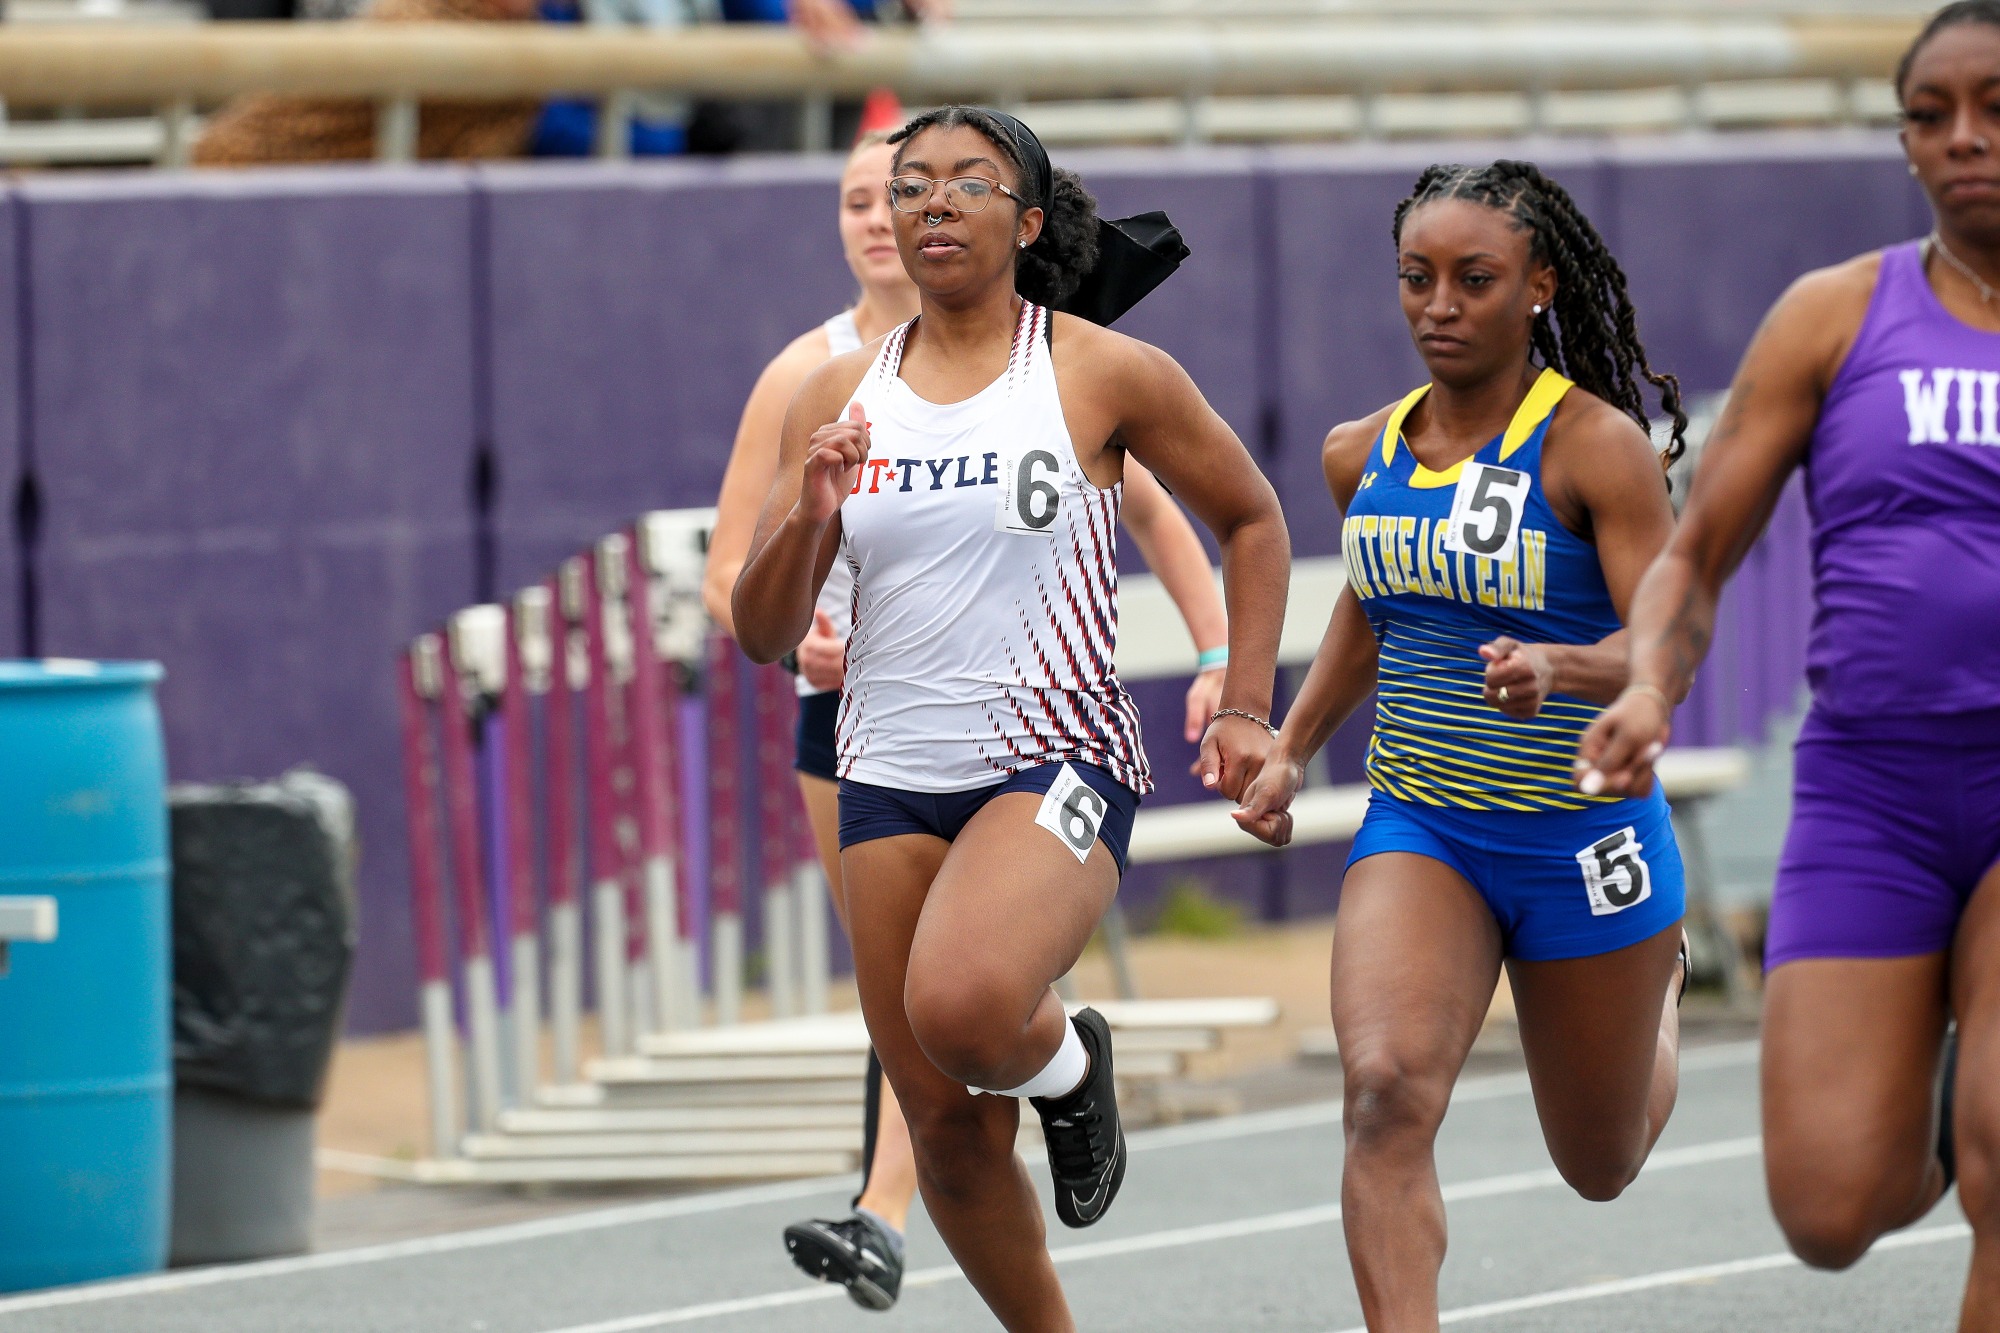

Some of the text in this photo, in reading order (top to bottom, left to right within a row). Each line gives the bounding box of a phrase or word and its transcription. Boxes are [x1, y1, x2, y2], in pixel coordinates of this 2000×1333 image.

[1017, 450, 1059, 529] 6
[1462, 467, 1520, 554] 5
[1060, 785, 1103, 850] 6
[1593, 831, 1643, 907] 5
